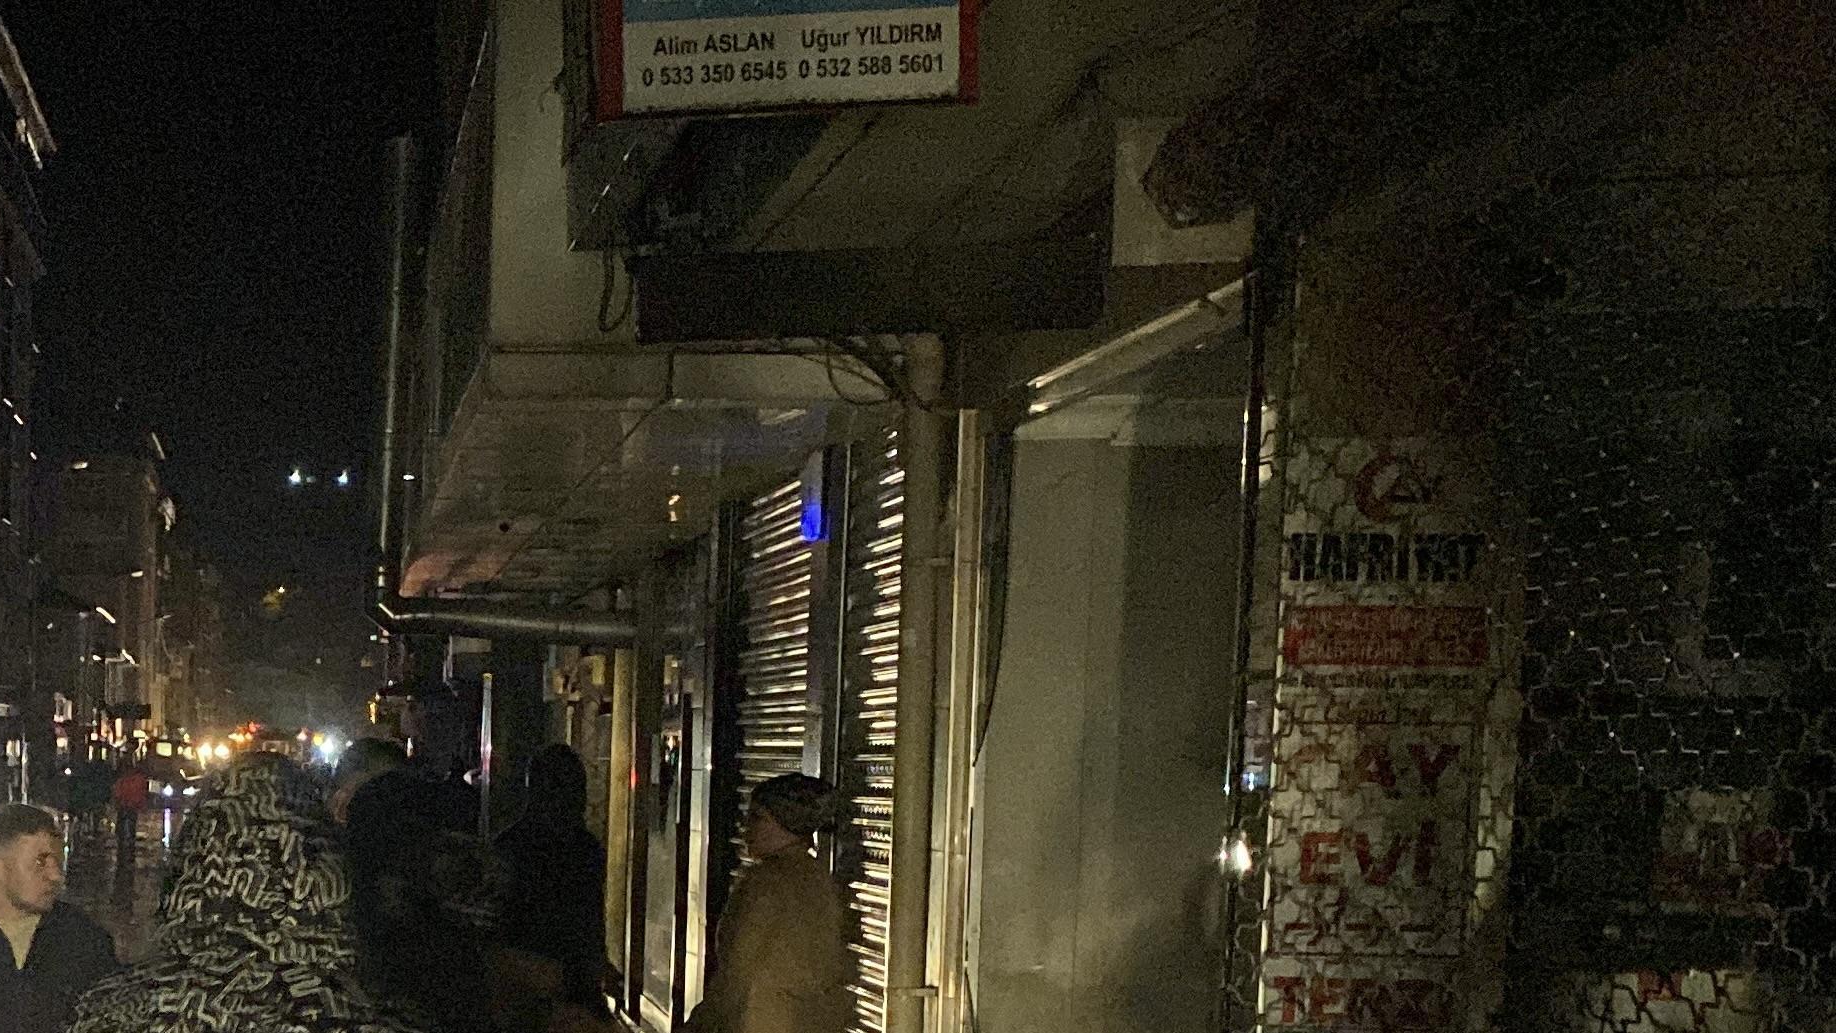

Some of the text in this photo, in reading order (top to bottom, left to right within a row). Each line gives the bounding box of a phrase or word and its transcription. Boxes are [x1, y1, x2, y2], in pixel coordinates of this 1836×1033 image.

[652, 23, 943, 57] Alim ASLAN Uğur YILDIRM
[643, 67, 654, 87] 0
[660, 65, 694, 85] 533
[701, 63, 736, 84] 350
[740, 61, 788, 82] 6545
[798, 60, 811, 79] 0
[817, 57, 852, 78] 532
[898, 53, 944, 75] 5601
